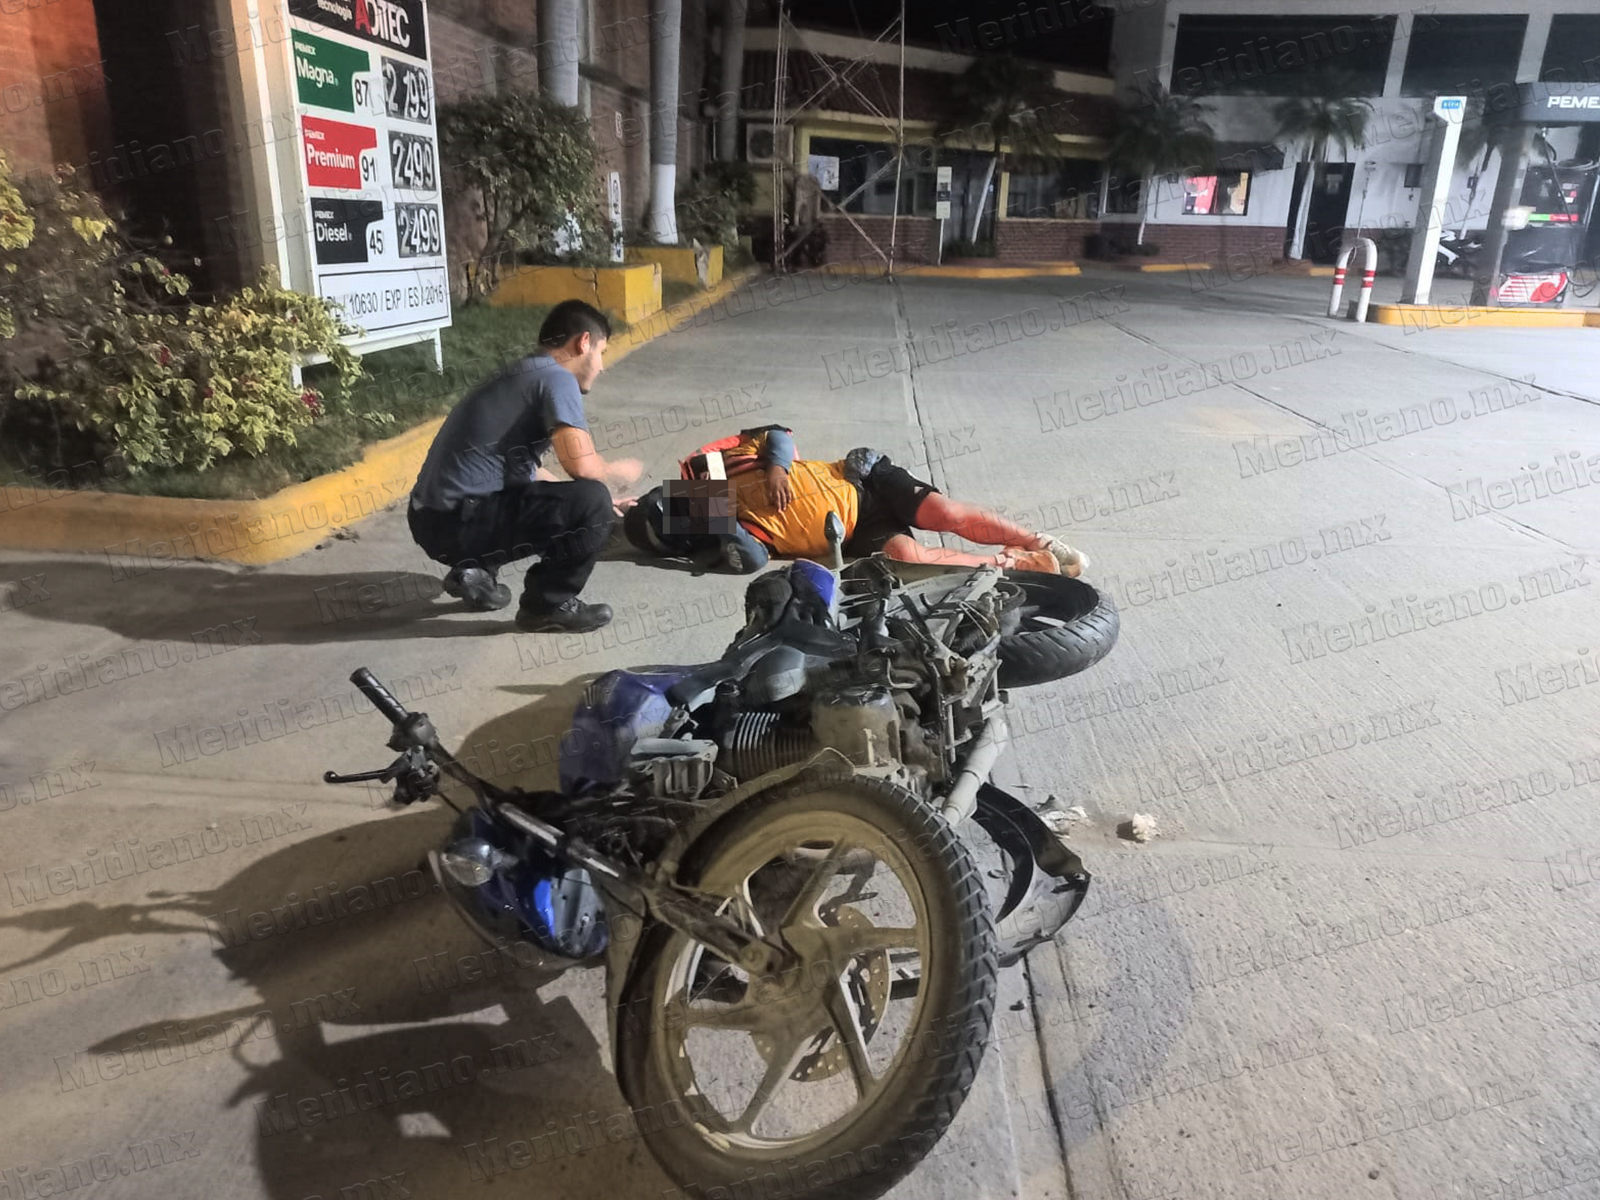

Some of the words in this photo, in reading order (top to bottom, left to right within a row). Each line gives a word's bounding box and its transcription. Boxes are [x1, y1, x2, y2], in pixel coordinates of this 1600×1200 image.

[296, 56, 335, 88] Magna
[355, 79, 369, 107] 87
[306, 144, 355, 170] Premium
[361, 155, 378, 182] 91
[315, 223, 349, 242] Diesel
[369, 230, 384, 254] 45
